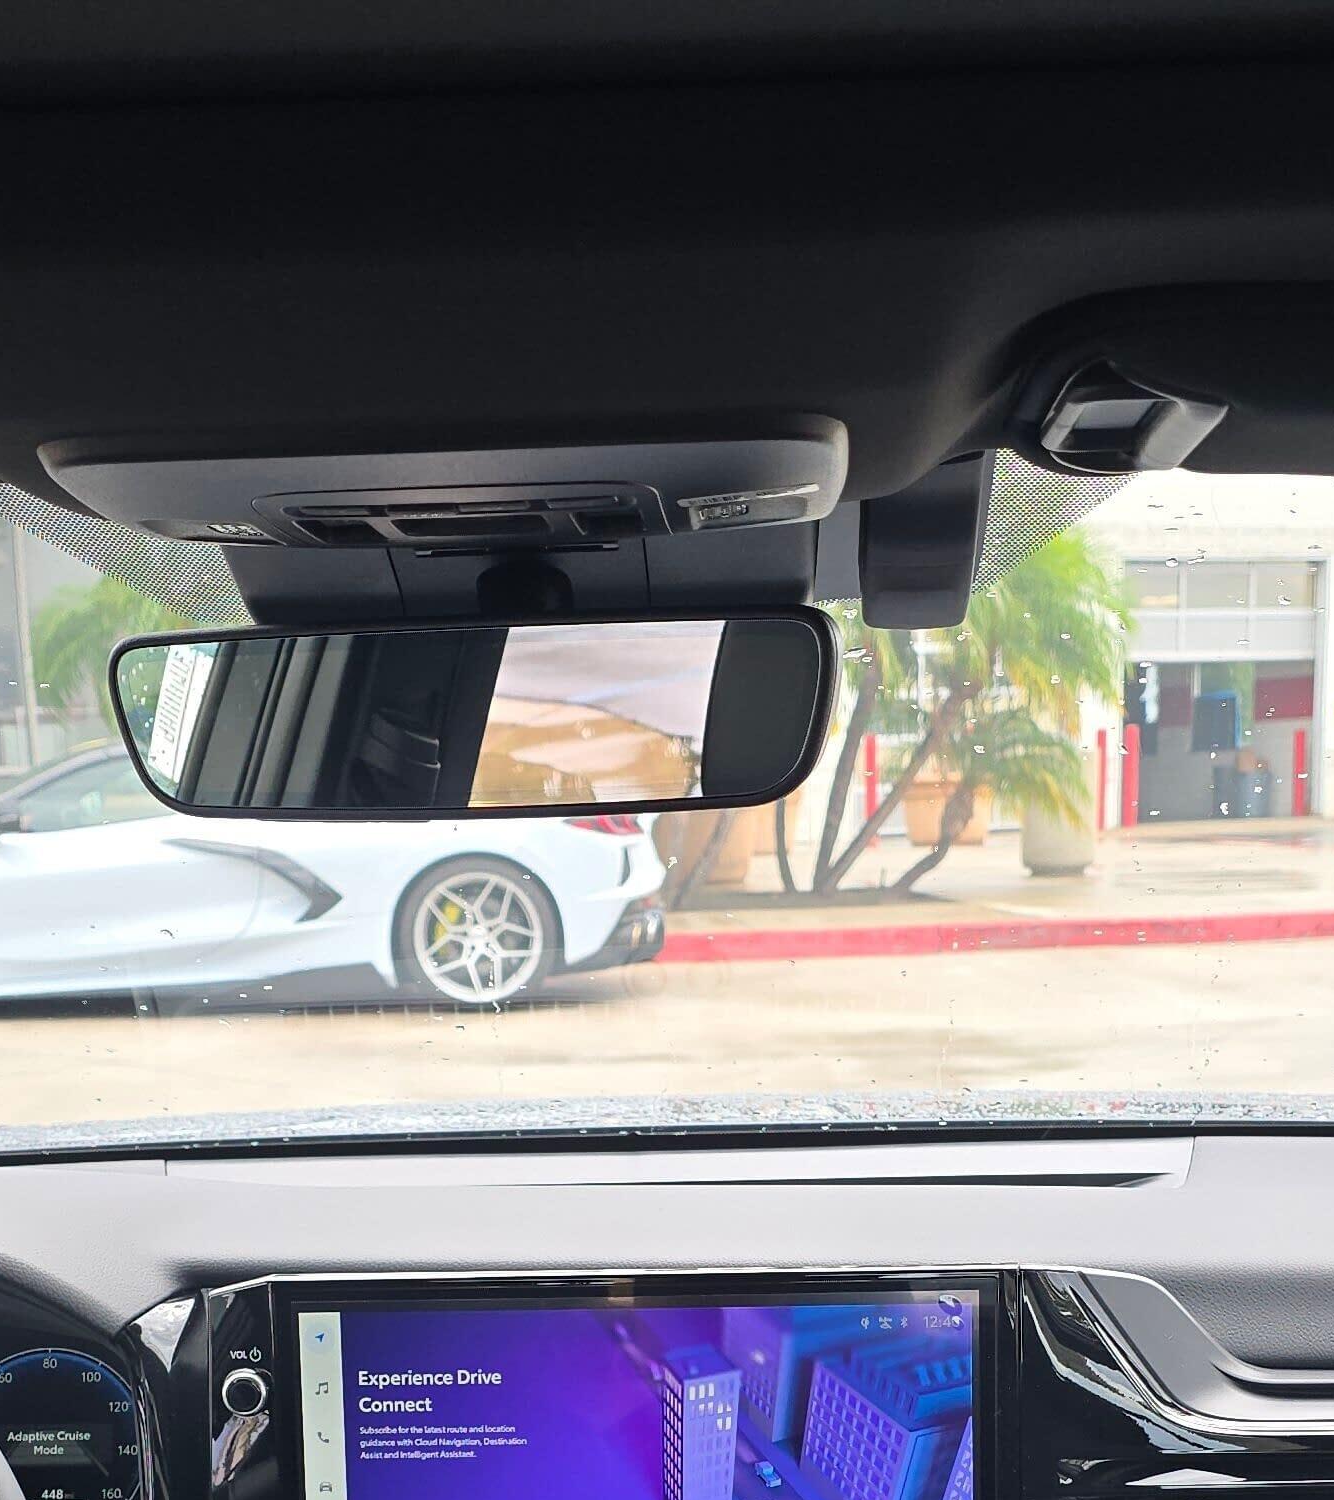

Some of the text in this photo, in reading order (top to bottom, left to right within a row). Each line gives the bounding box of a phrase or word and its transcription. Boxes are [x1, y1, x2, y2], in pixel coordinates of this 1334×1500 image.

[229, 1350, 247, 1360] VOL
[42, 1359, 57, 1369] 80
[81, 1372, 101, 1383] 100
[358, 1369, 502, 1389] Experience Drive
[108, 1401, 129, 1412] 120
[358, 1397, 433, 1413] Connect
[359, 1425, 516, 1435] Subscribe for the latest route and location
[7, 1430, 91, 1443] Adaptive Cruise
[359, 1437, 527, 1449] guidance with Cloud Navigation, Destination
[33, 1445, 64, 1455] Mode
[118, 1444, 138, 1456] 140
[360, 1450, 477, 1460] Assist and Intelligent Assistant.
[41, 1489, 64, 1500] 448
[101, 1488, 122, 1499] 160
